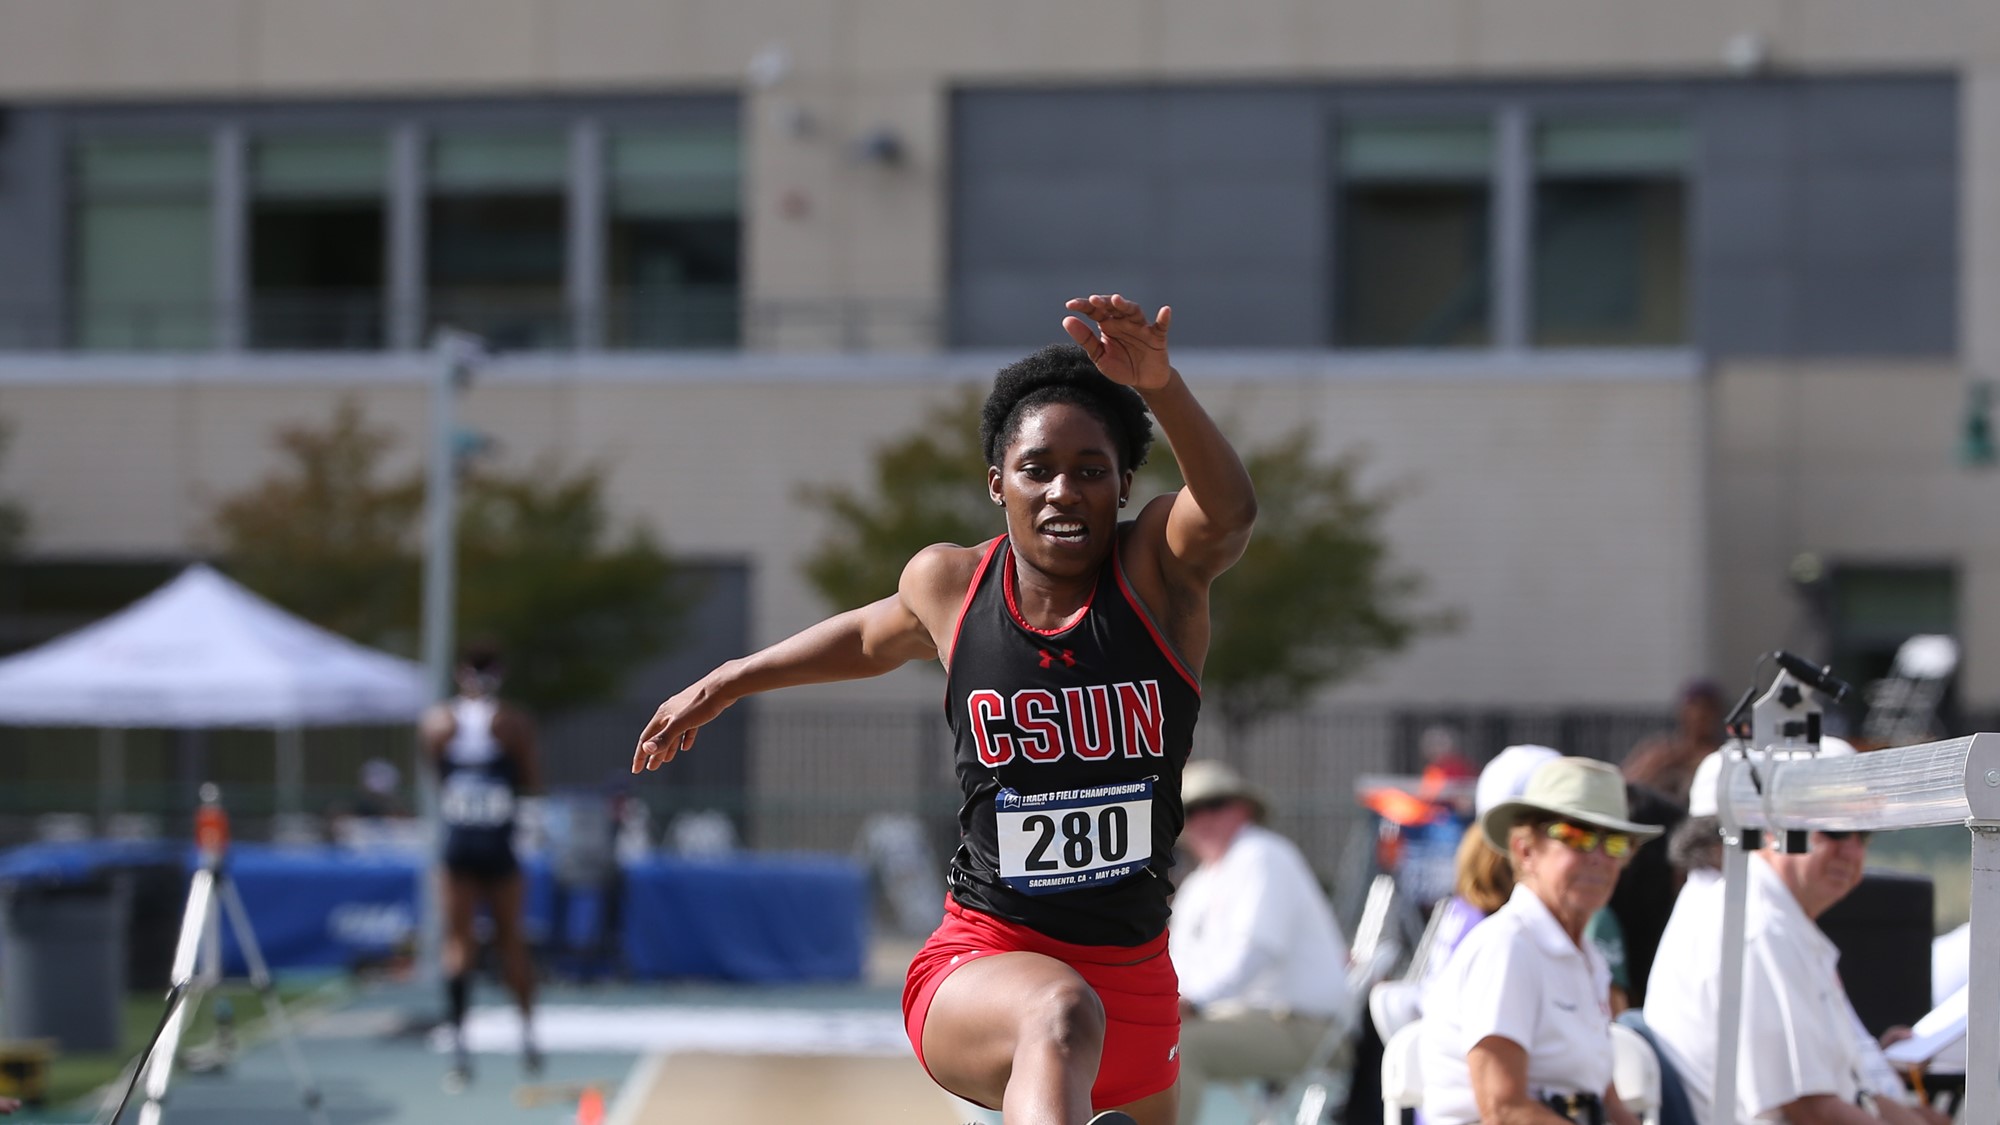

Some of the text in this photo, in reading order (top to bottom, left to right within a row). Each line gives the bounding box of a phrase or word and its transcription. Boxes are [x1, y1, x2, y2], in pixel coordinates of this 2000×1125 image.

[967, 680, 1164, 768] CSUN
[1048, 792, 1055, 801] &
[1056, 790, 1079, 801] FIELD
[1080, 783, 1146, 799] CHAMPIONSHIPS
[1022, 806, 1128, 871] 280
[1028, 867, 1130, 888] SACRAMENTO, CA MAY 24-26
